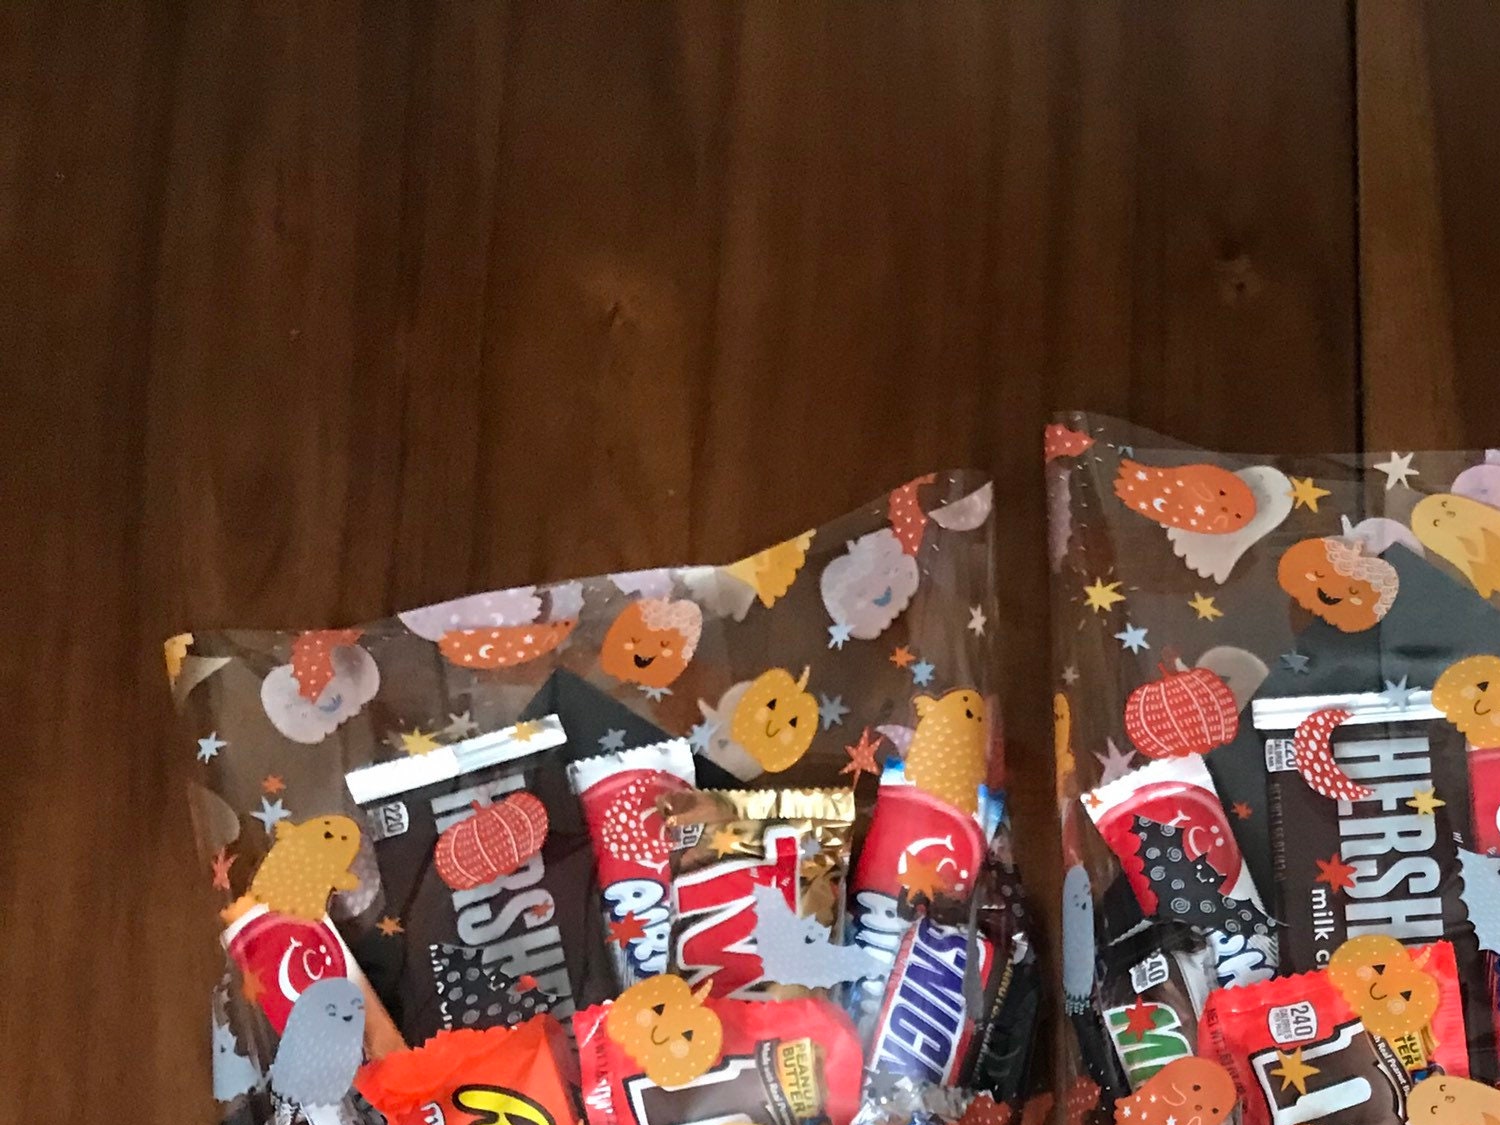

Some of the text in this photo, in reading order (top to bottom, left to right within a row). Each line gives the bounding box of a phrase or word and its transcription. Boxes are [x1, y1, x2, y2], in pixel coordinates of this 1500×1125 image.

[382, 802, 406, 835] 220
[1311, 889, 1335, 941] milk
[1289, 1005, 1314, 1037] 240
[784, 1047, 804, 1112] BUTTER
[797, 1044, 813, 1108] PEANUT
[1377, 1042, 1392, 1059] Real
[1387, 1058, 1407, 1085] Peanut
